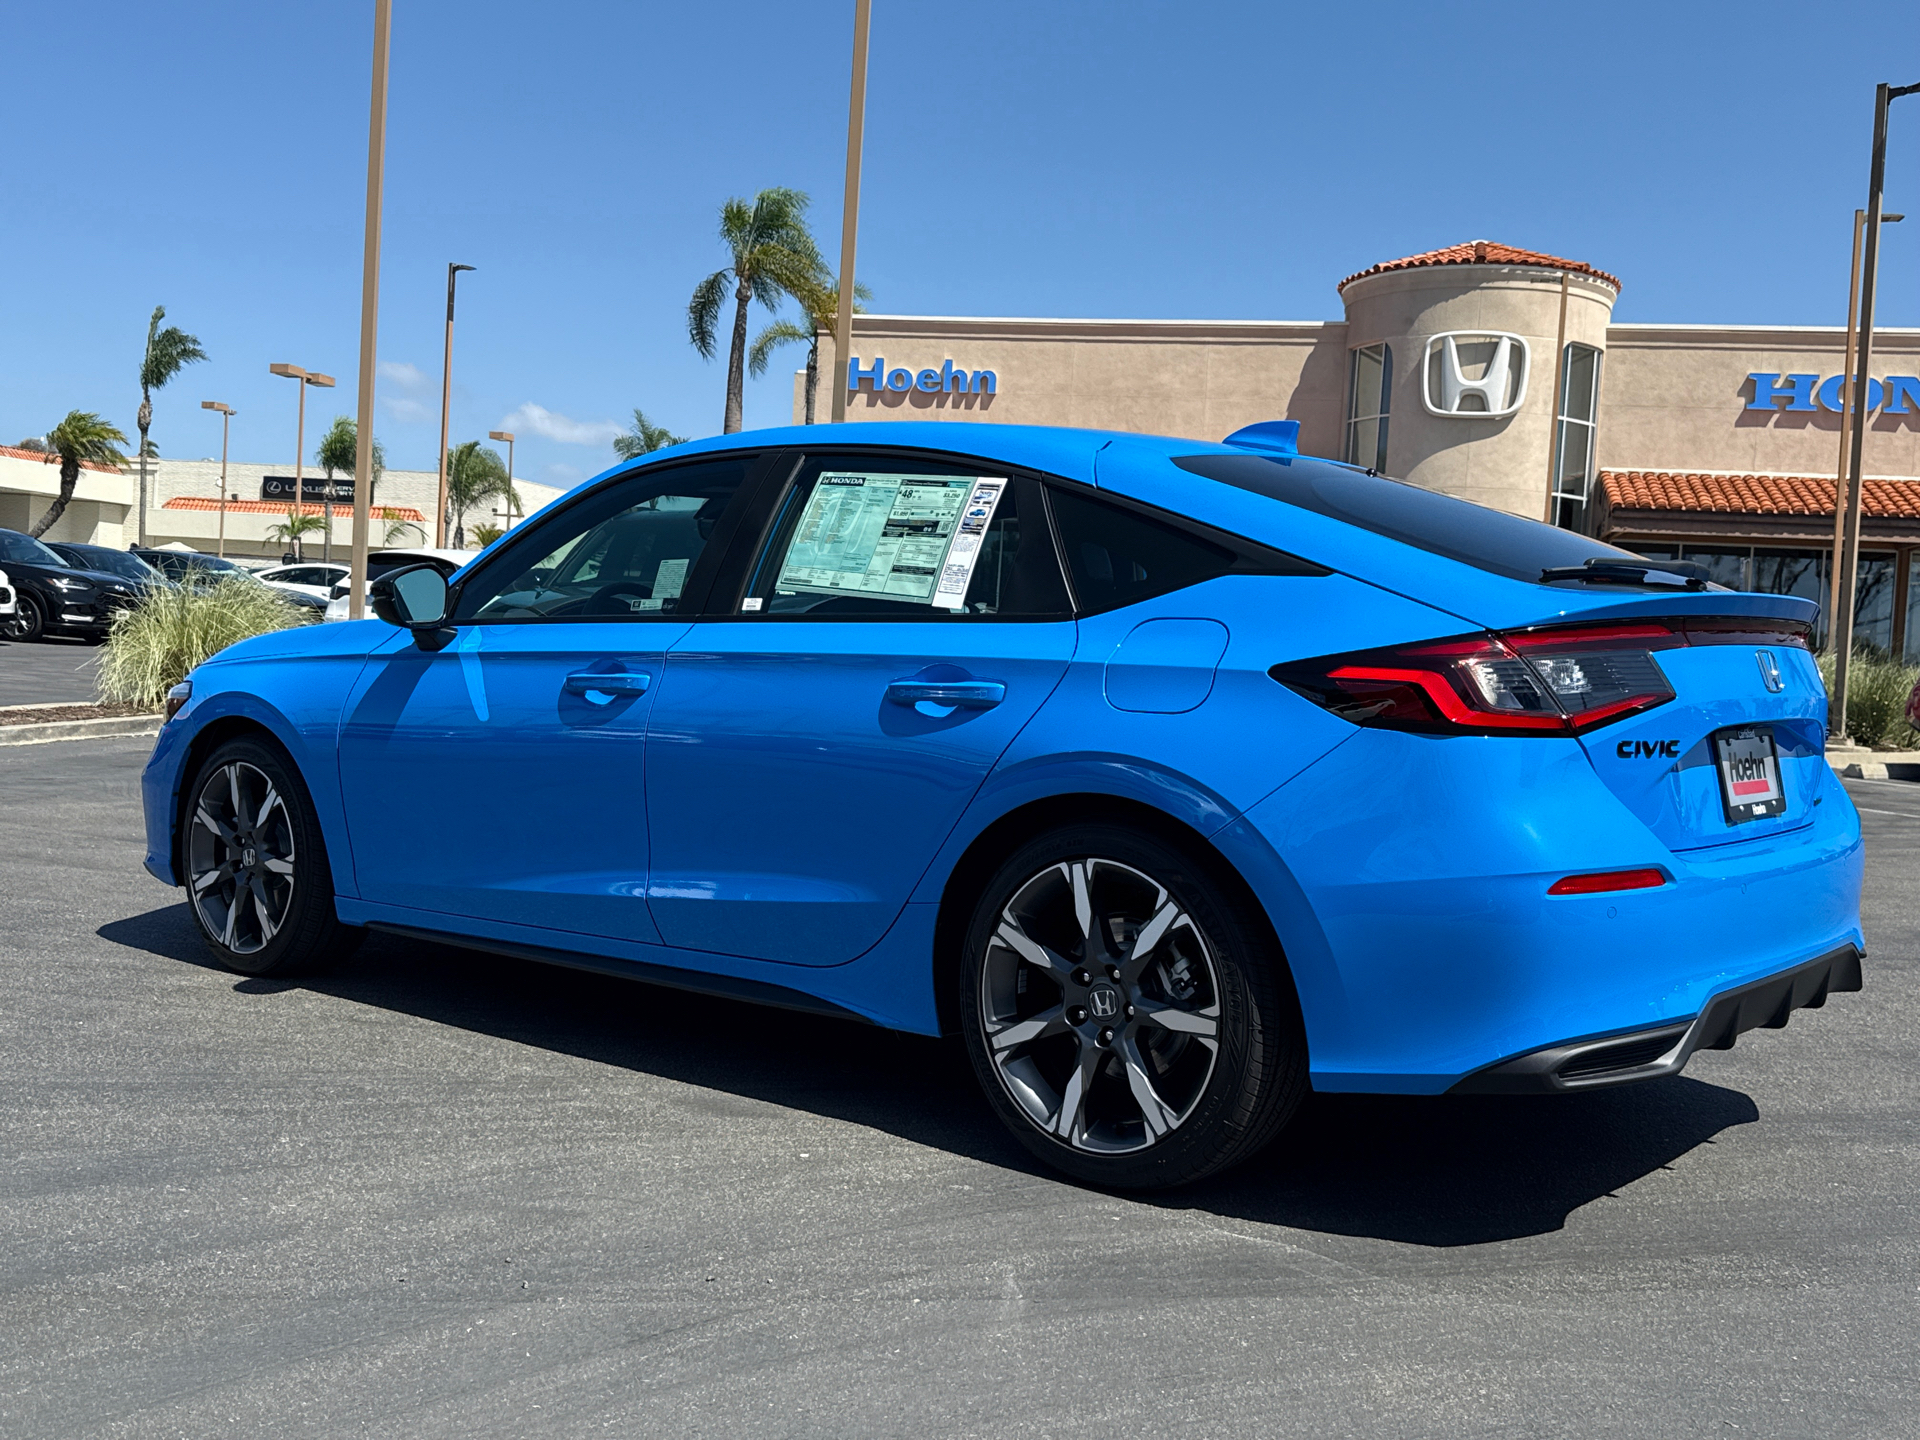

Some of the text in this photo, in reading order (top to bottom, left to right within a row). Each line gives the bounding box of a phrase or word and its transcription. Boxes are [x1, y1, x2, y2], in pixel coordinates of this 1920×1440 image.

[848, 357, 998, 394] Hoehn
[830, 477, 864, 485] HONDA
[901, 489, 914, 499] 48
[1617, 740, 1680, 759] CIVIC
[1728, 751, 1767, 783] Hoehn
